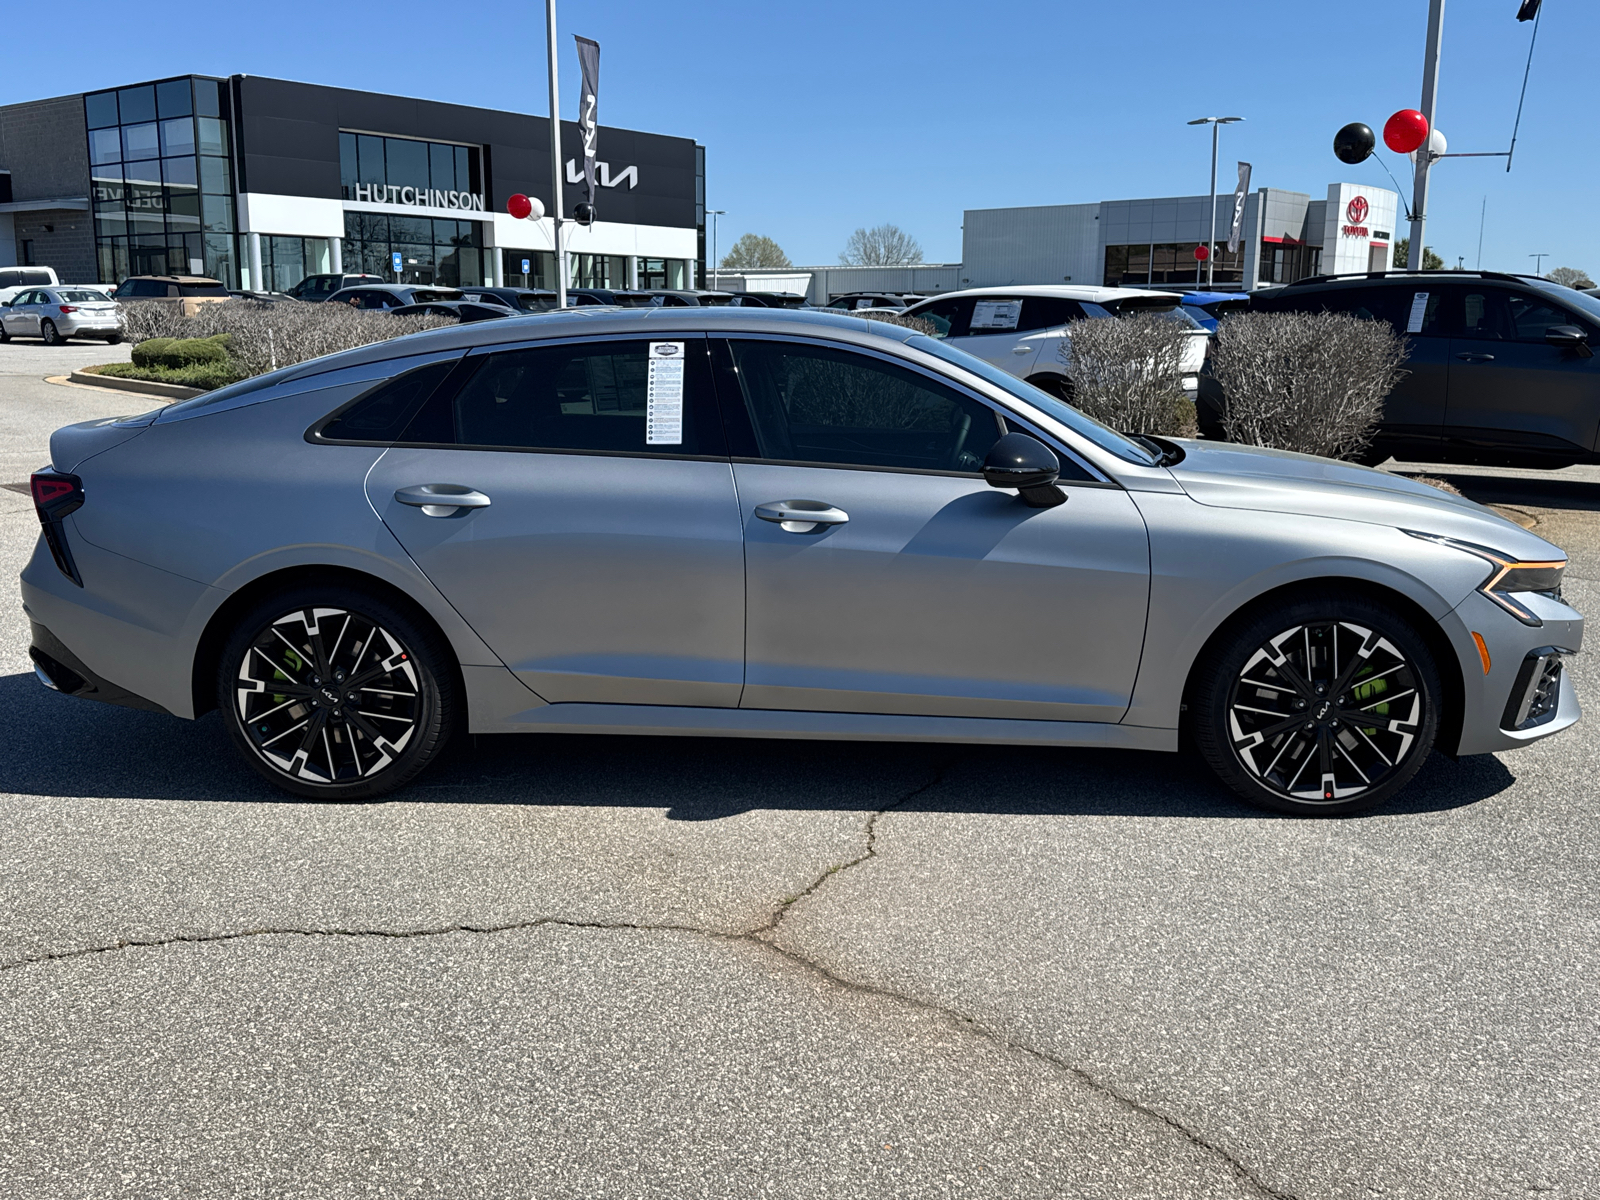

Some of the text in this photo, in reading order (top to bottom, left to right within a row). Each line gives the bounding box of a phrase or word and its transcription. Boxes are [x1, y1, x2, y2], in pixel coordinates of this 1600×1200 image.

[565, 158, 638, 190] KIA
[355, 182, 484, 212] HUTCHINSON
[1342, 225, 1369, 238] TOYOTA
[321, 688, 339, 703] KIA
[1316, 701, 1331, 720] KIA
